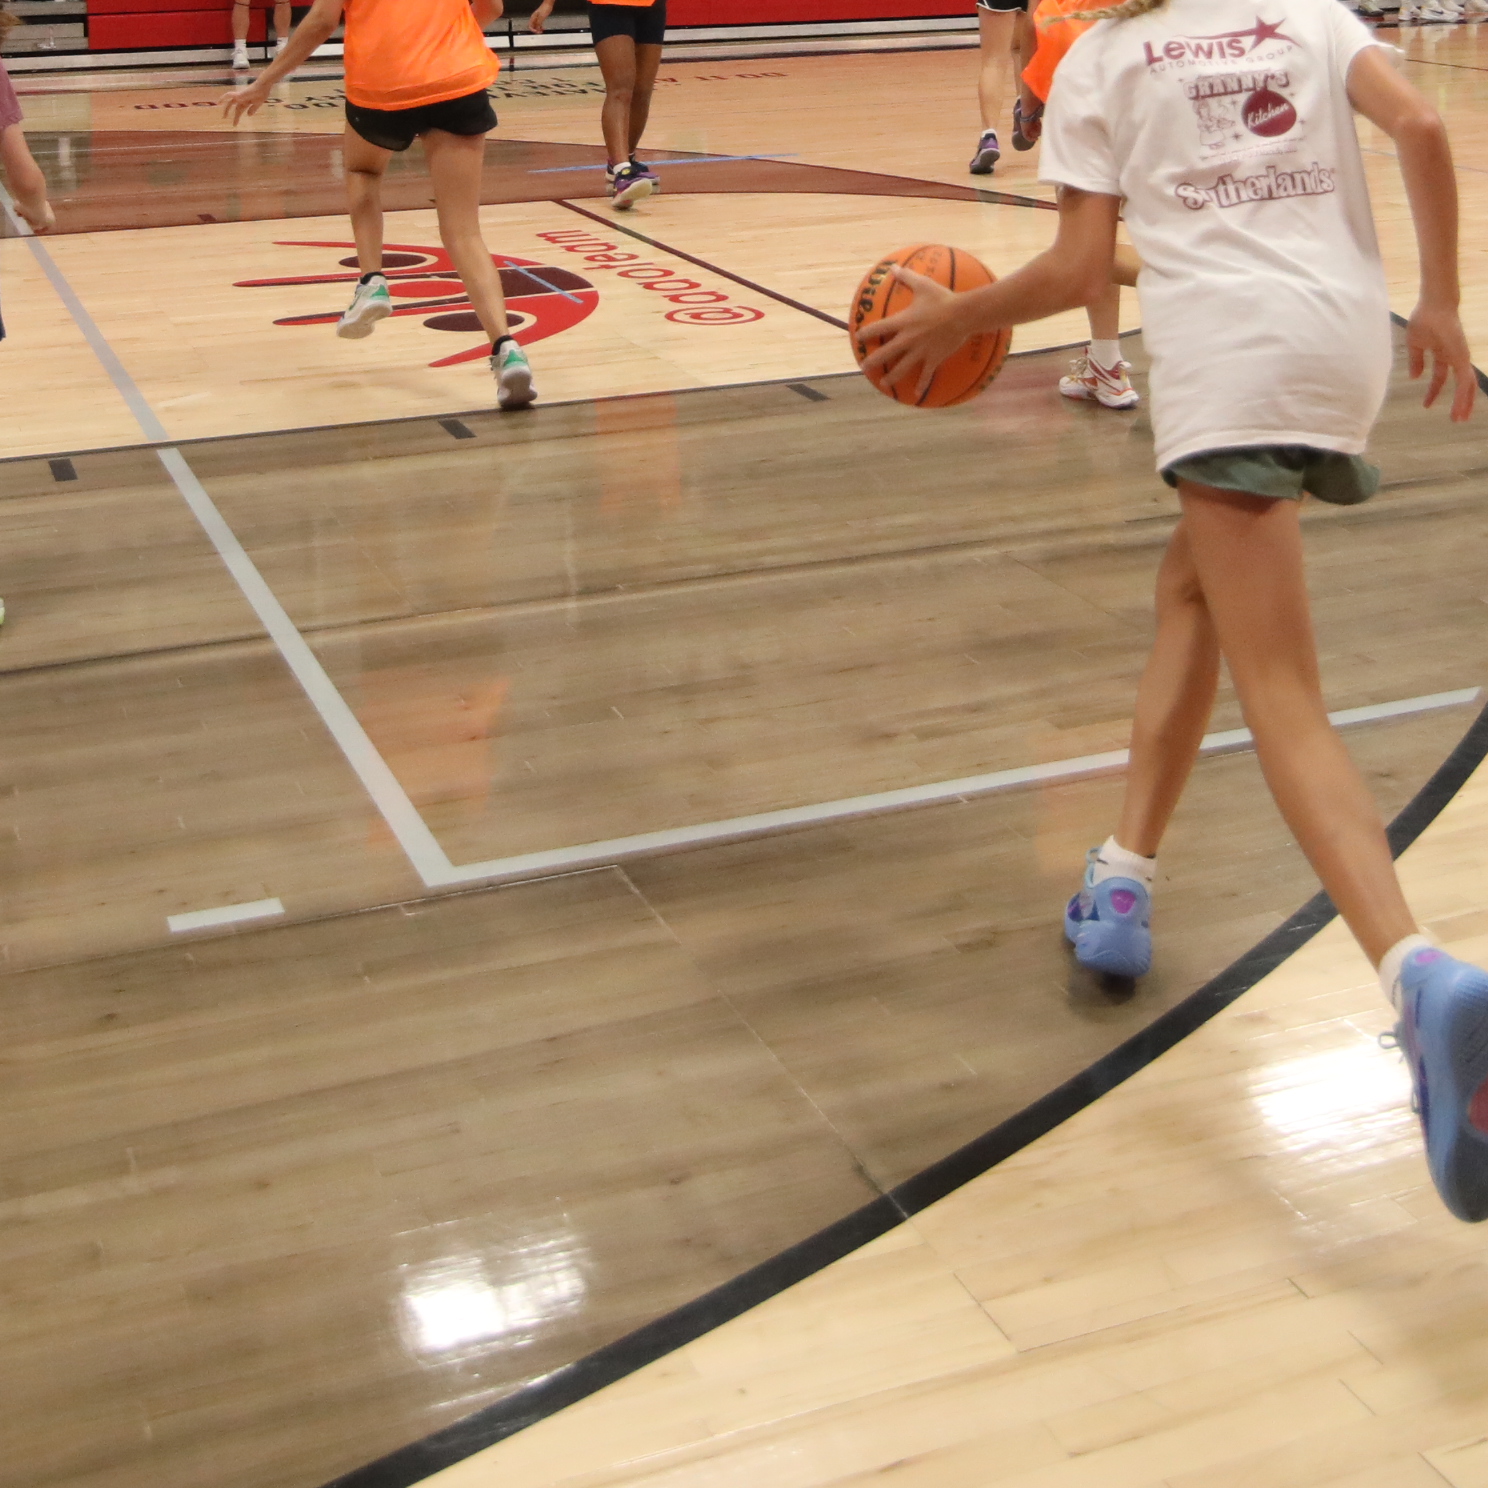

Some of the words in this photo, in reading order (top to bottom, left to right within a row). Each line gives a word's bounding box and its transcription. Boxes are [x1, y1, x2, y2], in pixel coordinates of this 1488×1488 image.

[1247, 102, 1291, 128] Kitchen
[1175, 162, 1335, 210] Sutherlands
[536, 229, 765, 326] @aaoteam
